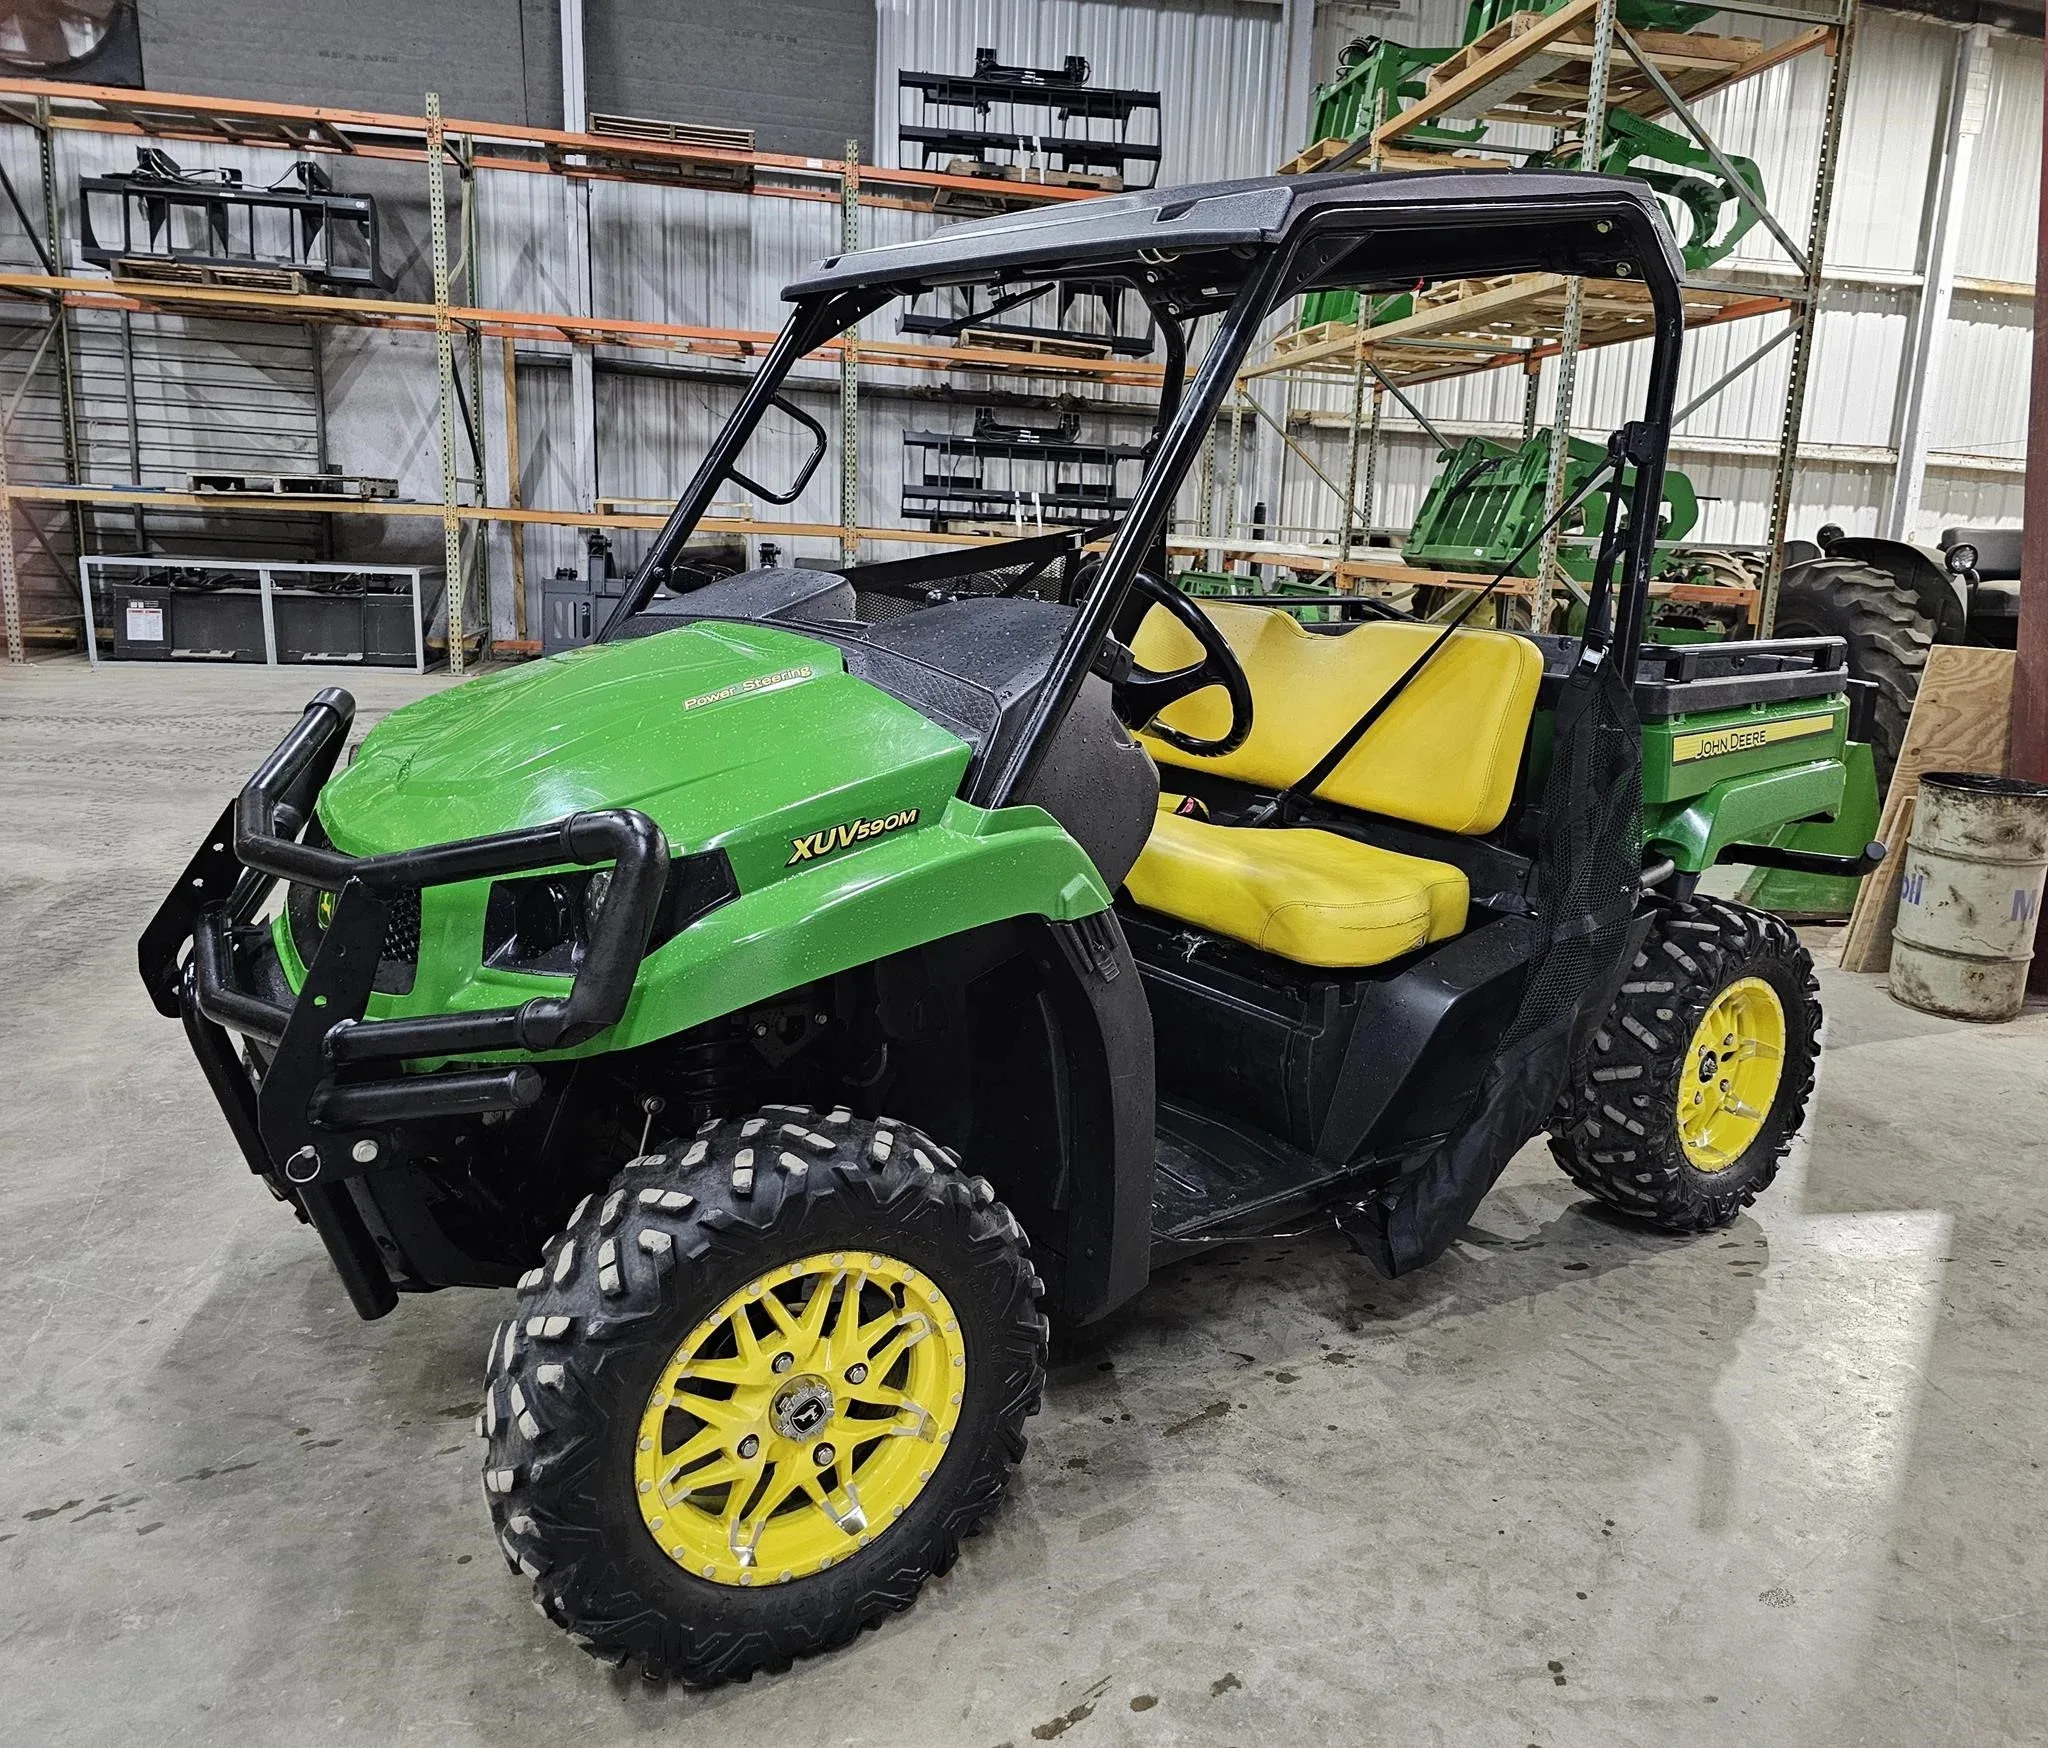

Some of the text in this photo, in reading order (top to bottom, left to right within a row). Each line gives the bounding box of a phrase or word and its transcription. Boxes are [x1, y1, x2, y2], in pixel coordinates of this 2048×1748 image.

[684, 666, 812, 711] Power Steering
[1697, 730, 1766, 757] JOHN DEERE
